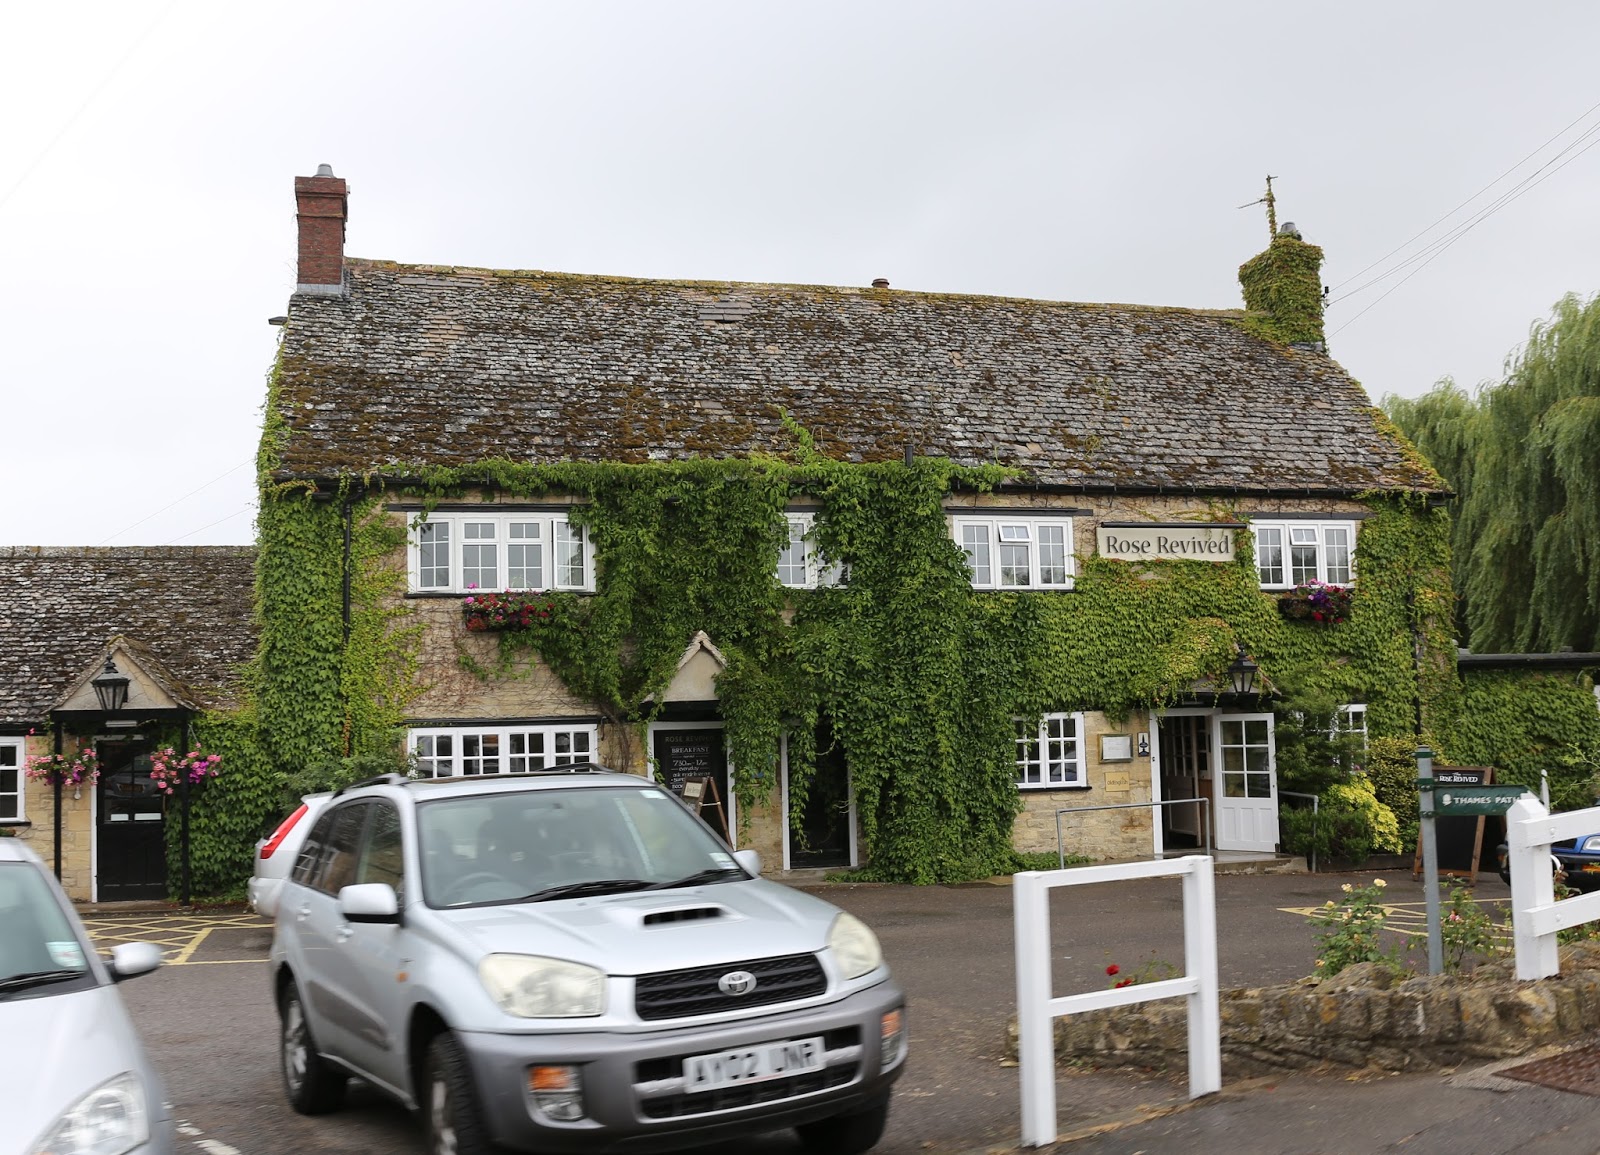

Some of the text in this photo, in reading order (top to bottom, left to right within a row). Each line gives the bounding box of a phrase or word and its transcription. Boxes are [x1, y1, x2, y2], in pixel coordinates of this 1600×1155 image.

[1106, 535, 1230, 554] Rose Revived
[1453, 796, 1491, 804] THAMES
